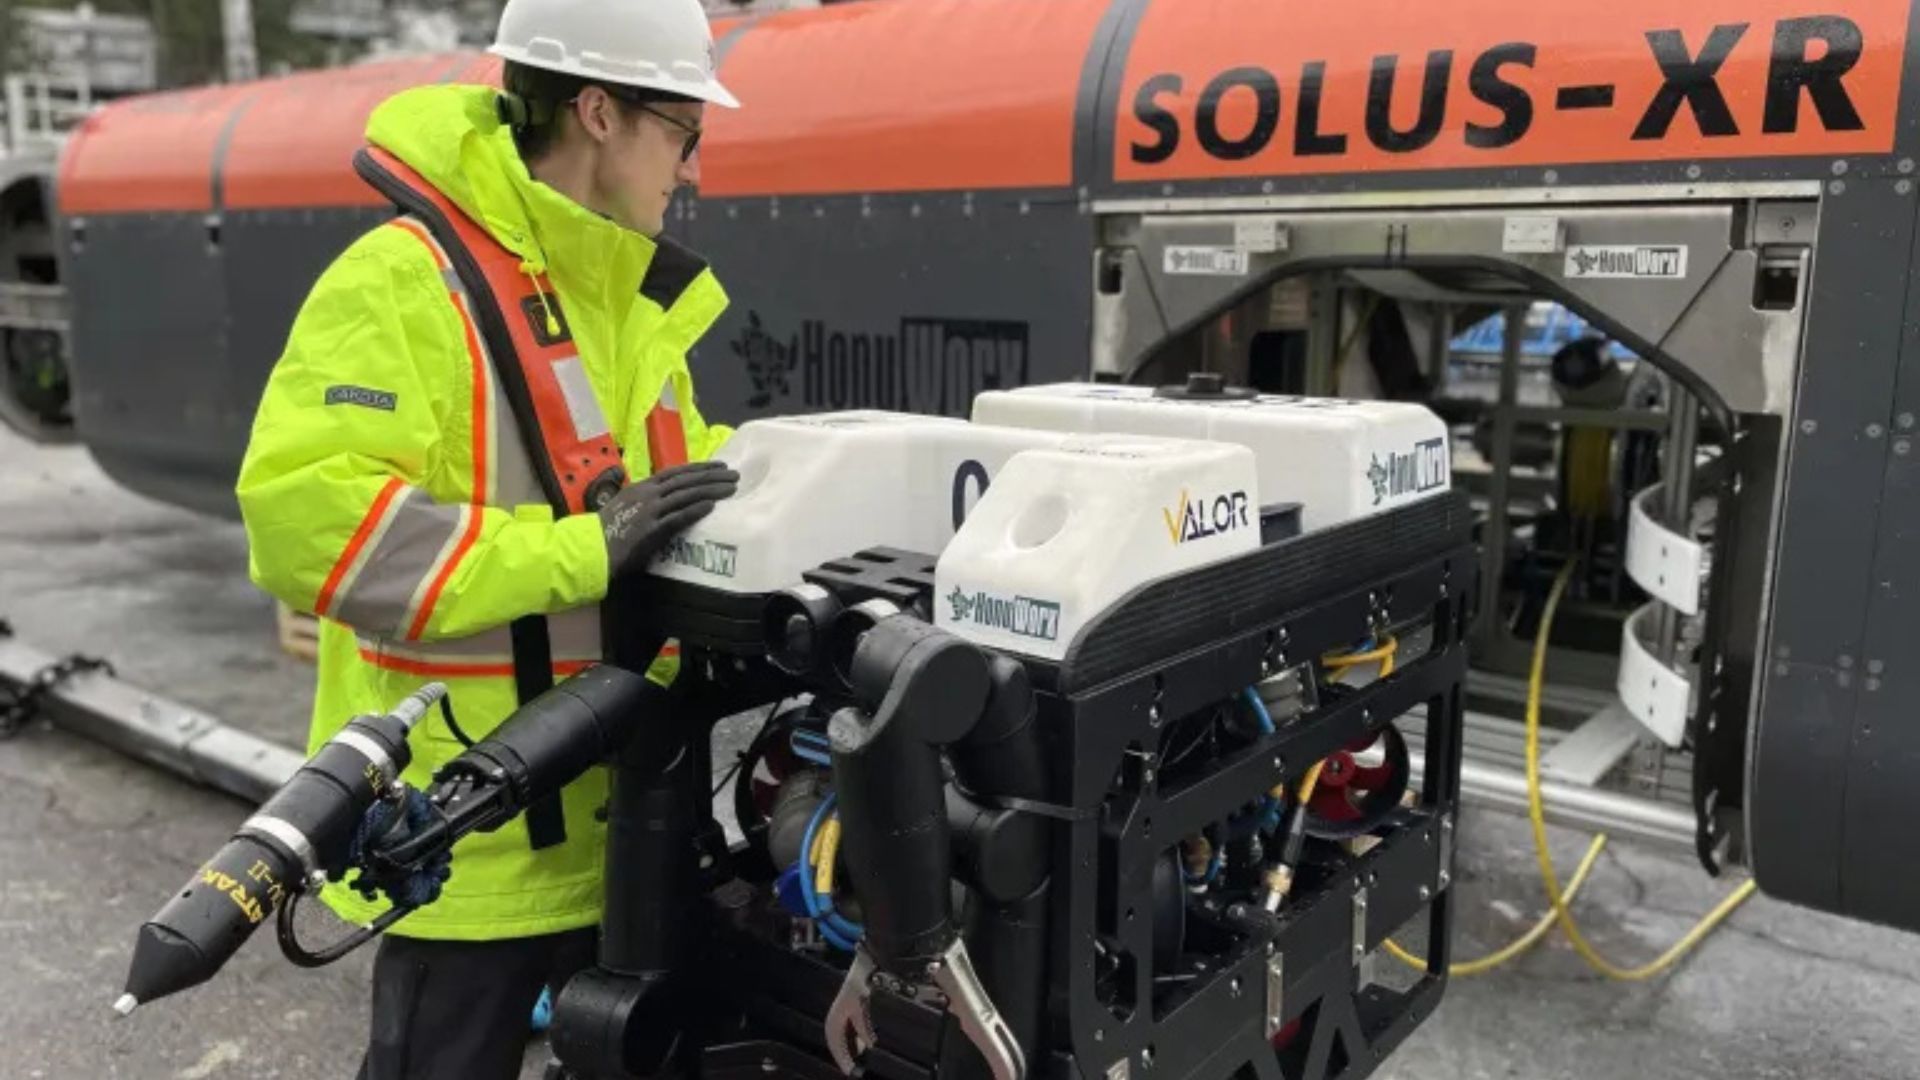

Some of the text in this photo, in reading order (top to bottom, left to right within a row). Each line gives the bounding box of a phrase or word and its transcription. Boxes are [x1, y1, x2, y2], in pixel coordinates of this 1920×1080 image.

[1131, 14, 1866, 164] SOLUS-XR
[1599, 247, 1681, 276] HonuWorx
[803, 318, 1028, 418] HonuWorx
[1389, 437, 1445, 497] HonuWorx
[1162, 488, 1248, 546] VALOR
[974, 592, 1060, 640] HonuWorx
